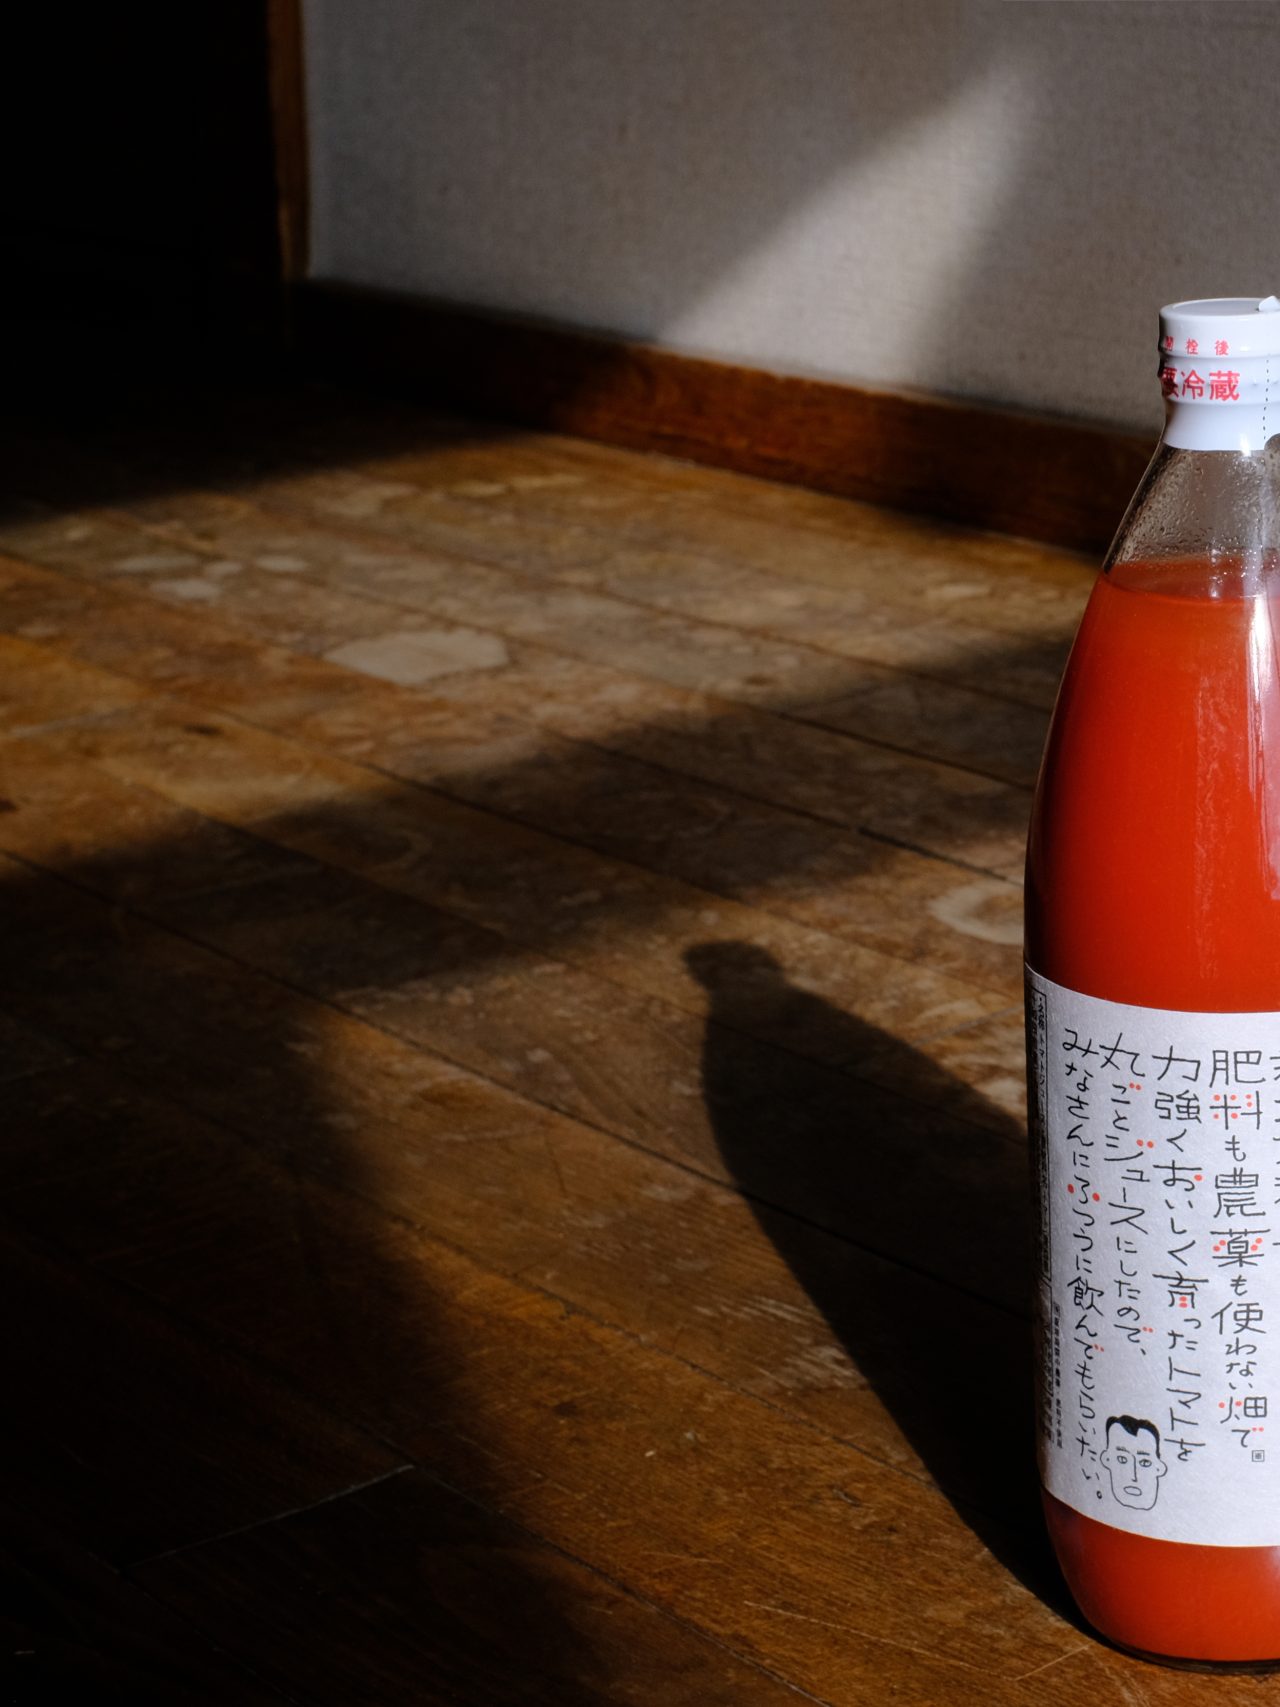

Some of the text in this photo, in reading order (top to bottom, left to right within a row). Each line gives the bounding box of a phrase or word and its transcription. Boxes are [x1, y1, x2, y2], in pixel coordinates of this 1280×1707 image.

[1161, 367, 1241, 402] 要冷蔵
[1098, 1031, 1156, 1357] 丸ごとジュースにしたので、
[1151, 1045, 1210, 1463] 力強くおいしく育ったトマトを
[1210, 1047, 1272, 1448] 肥料も農薬も使わない畑で
